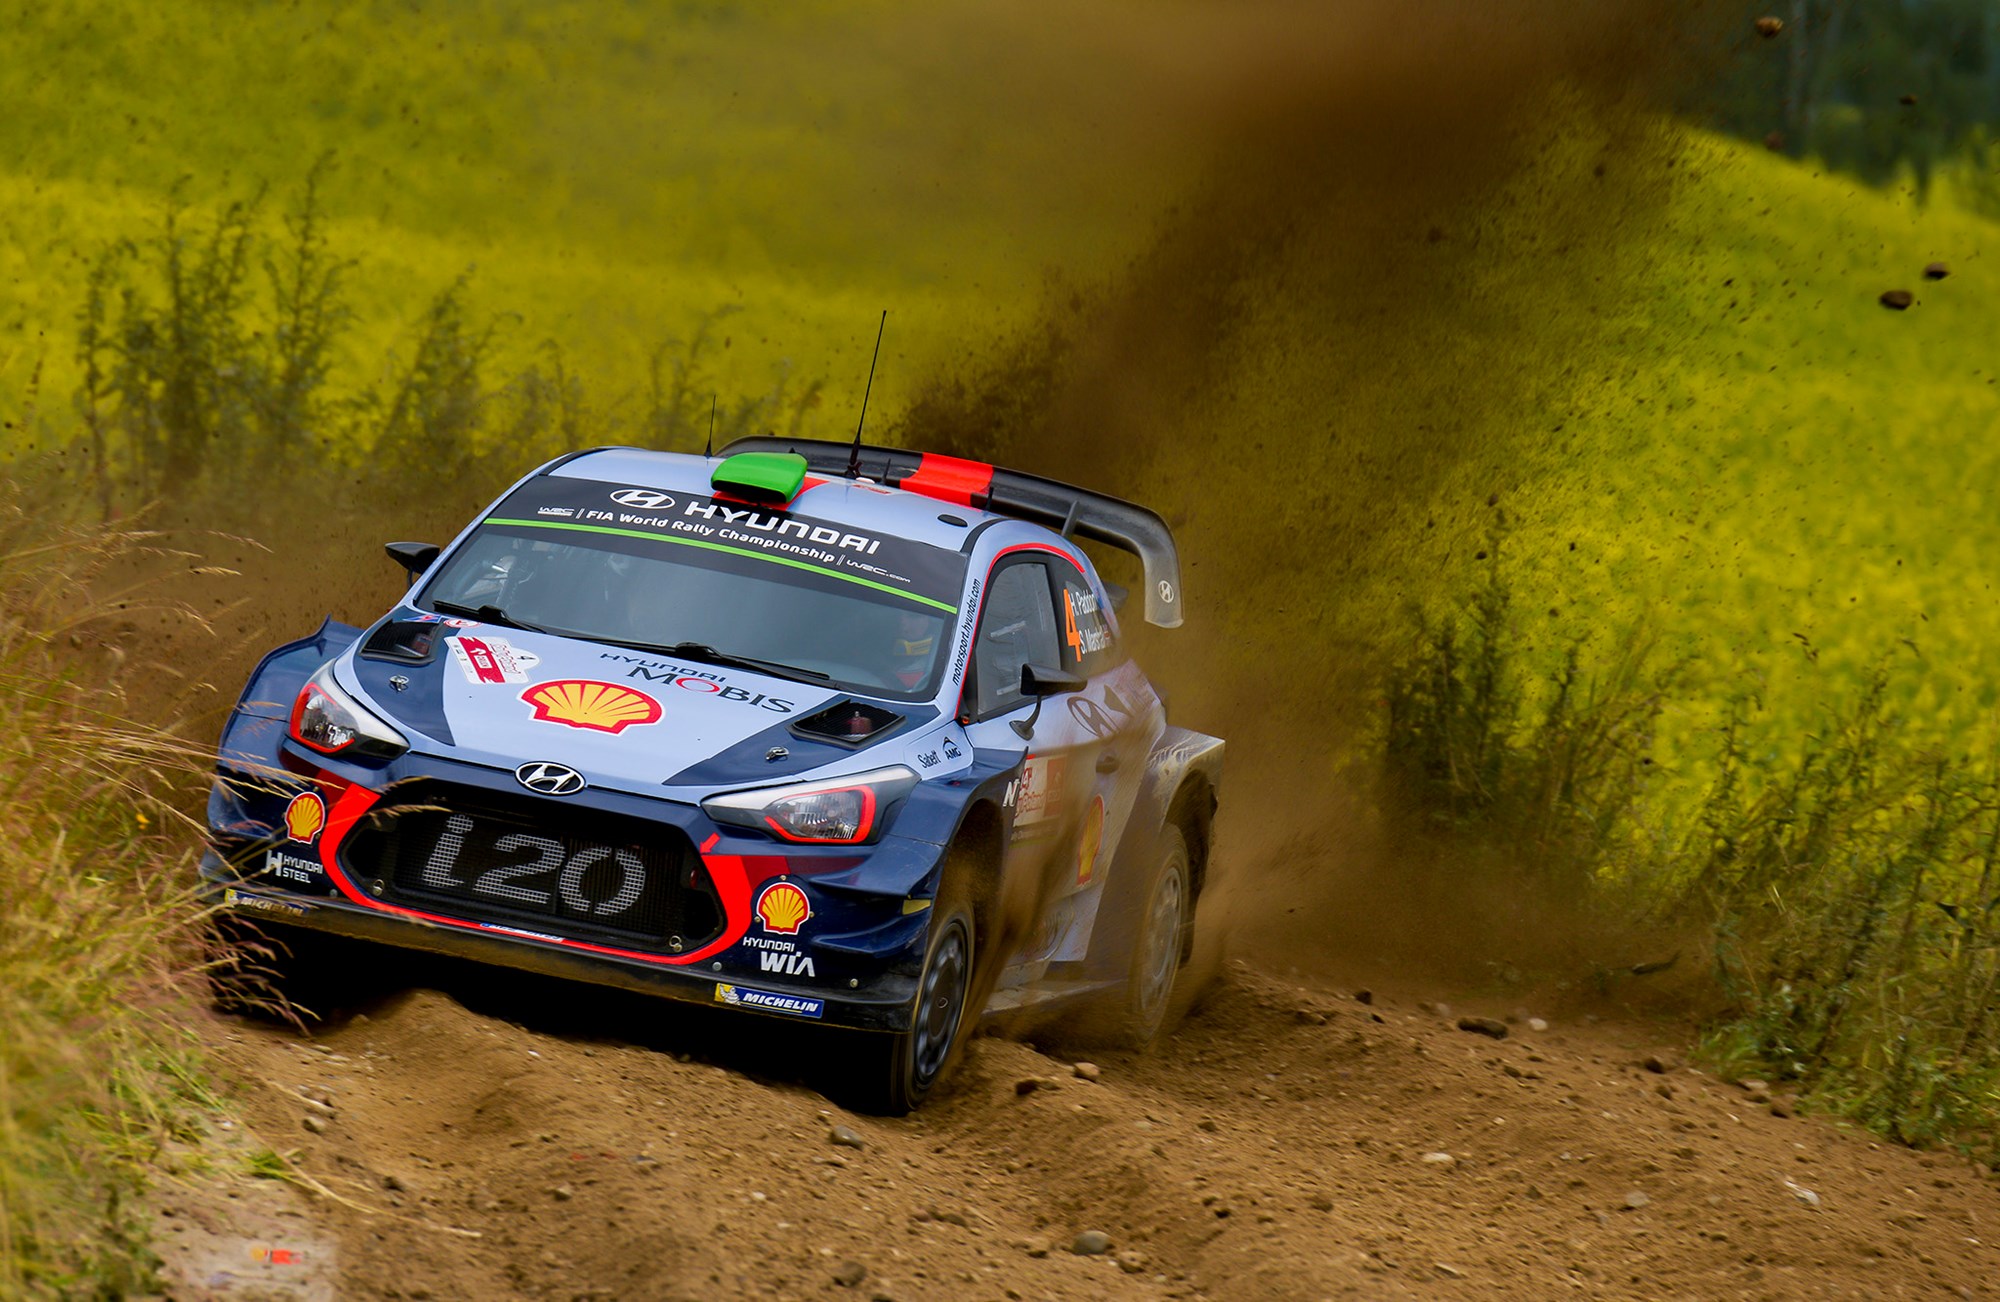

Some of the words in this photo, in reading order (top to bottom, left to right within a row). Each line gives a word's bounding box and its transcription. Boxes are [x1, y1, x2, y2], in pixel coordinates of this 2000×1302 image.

[586, 510, 614, 521] FIA
[619, 513, 668, 528] World
[671, 520, 715, 537] Rally
[718, 528, 836, 563] Championship
[684, 501, 881, 555] HYUNDAI
[952, 579, 981, 687] motorsport.hyundai.com
[1063, 588, 1082, 662] 4
[600, 653, 726, 683] HYUNDAI
[626, 666, 795, 714] MOBIS
[282, 867, 311, 884] STEEL
[283, 855, 324, 875] HYUNDAI
[742, 936, 795, 953] HYUNDAI
[742, 992, 819, 1013] MICHELIN
